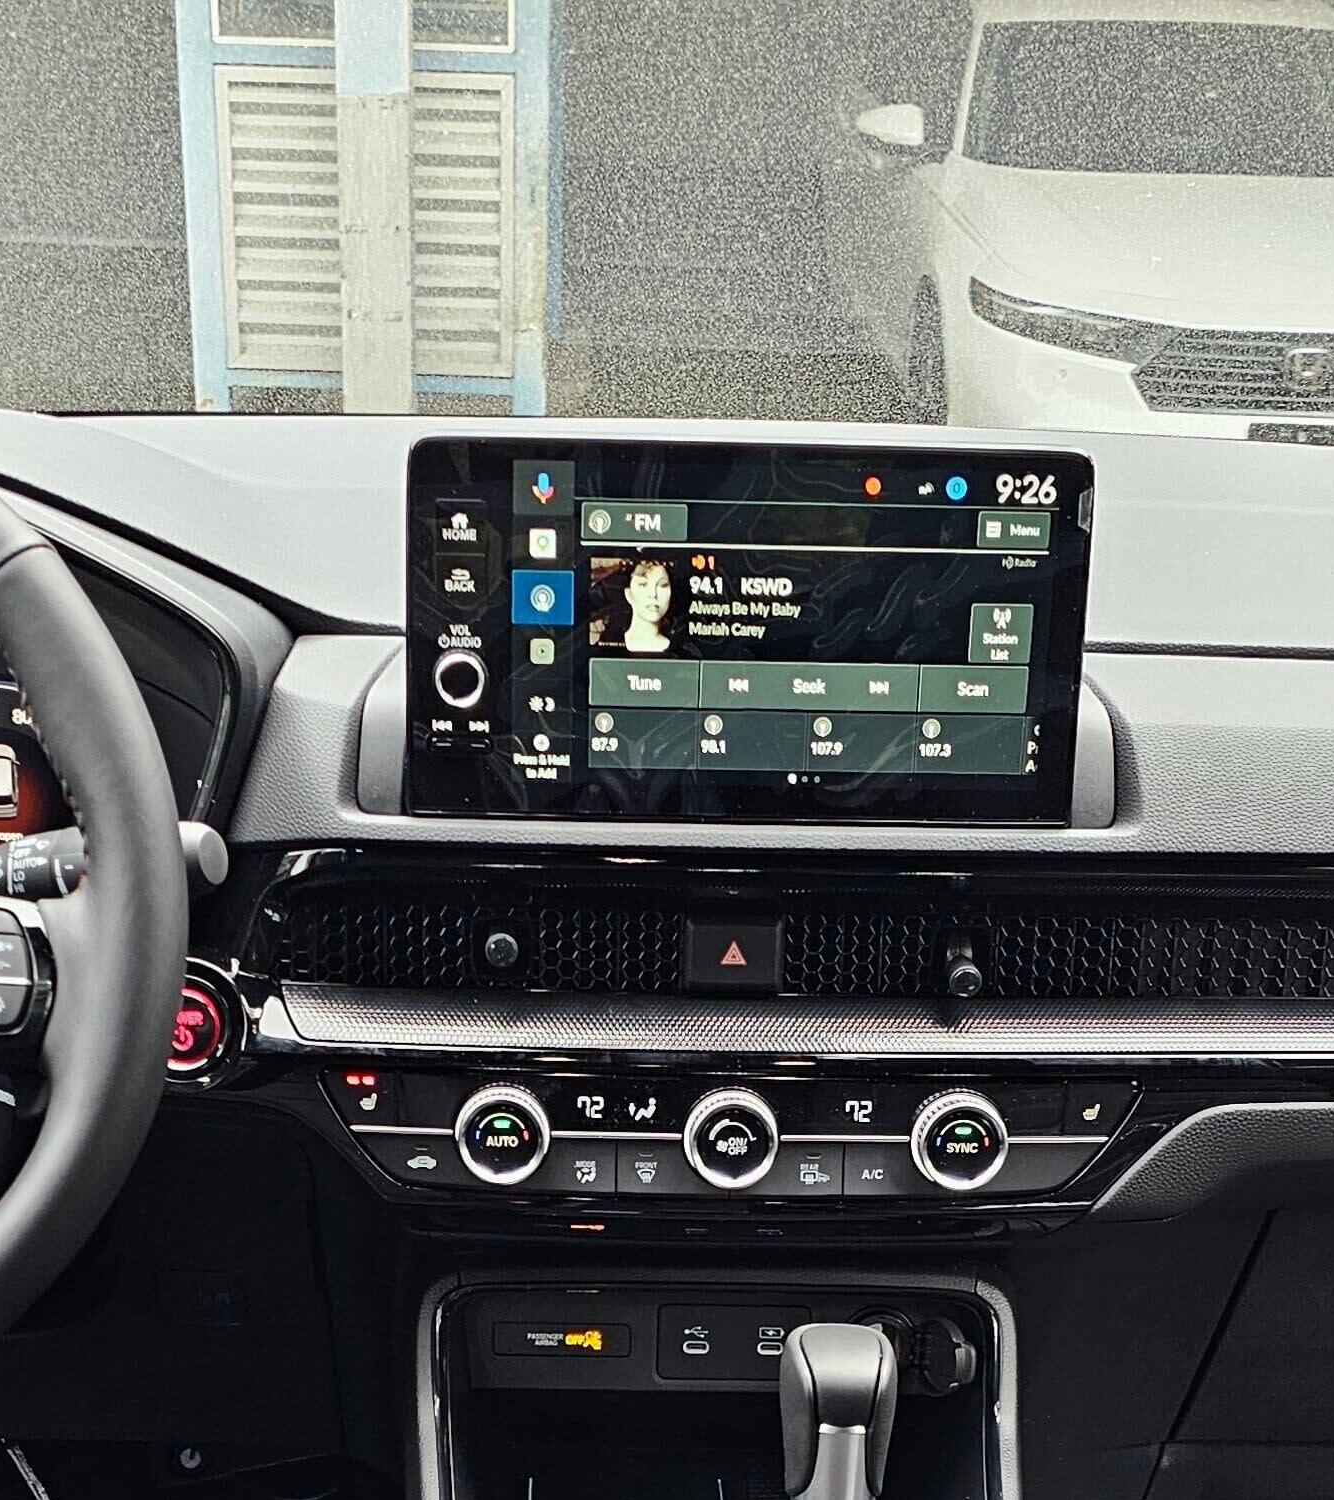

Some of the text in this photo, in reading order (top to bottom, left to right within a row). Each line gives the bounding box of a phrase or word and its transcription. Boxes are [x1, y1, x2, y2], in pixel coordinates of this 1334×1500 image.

[996, 474, 1057, 505] 9:26
[634, 513, 661, 532] FM
[441, 528, 477, 542] HOME
[1009, 523, 1041, 537] Menu
[444, 579, 476, 593] BACK
[689, 576, 793, 597] 94.1 KSWD
[689, 600, 801, 619] Always Be My Baby
[449, 624, 472, 636] VOL
[689, 621, 766, 640] Mariah Carey
[450, 636, 482, 649] AUDIO
[982, 632, 1019, 645] Station
[990, 648, 1010, 661] List
[627, 675, 662, 691] Tune
[792, 678, 826, 695] Seek
[956, 681, 989, 697] Scan
[810, 741, 844, 756] 107.9
[577, 1095, 605, 1119] 72
[845, 1100, 873, 1123] 72
[486, 1136, 519, 1148] AUTO
[946, 1142, 979, 1154] SYNC
[727, 1145, 748, 1156] OFF
[634, 1161, 658, 1169] FRONT
[861, 1169, 884, 1180] A/C
[527, 1332, 564, 1341] PASSENGER
[534, 1339, 559, 1347] AIRBAG
